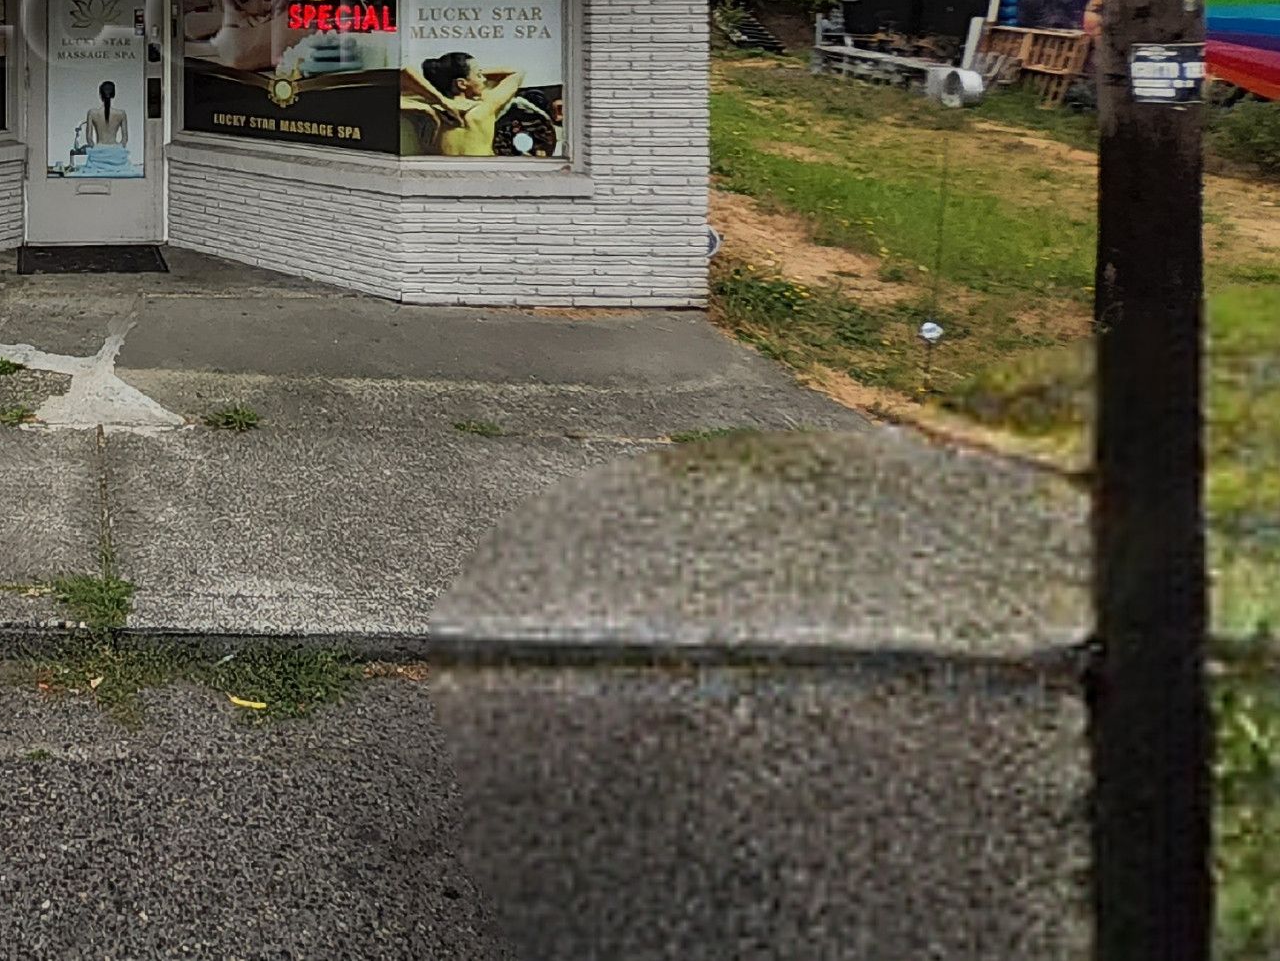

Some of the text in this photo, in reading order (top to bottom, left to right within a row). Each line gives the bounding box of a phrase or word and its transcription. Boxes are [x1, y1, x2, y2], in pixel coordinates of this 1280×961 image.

[288, 4, 398, 33] SPECIAL
[418, 7, 543, 21] LUCKY STAR
[410, 25, 551, 39] MASSAGE SPA
[57, 51, 136, 60] MASSAGE SPA
[213, 113, 362, 140] LUCKY STAR MASSAGE SPA
